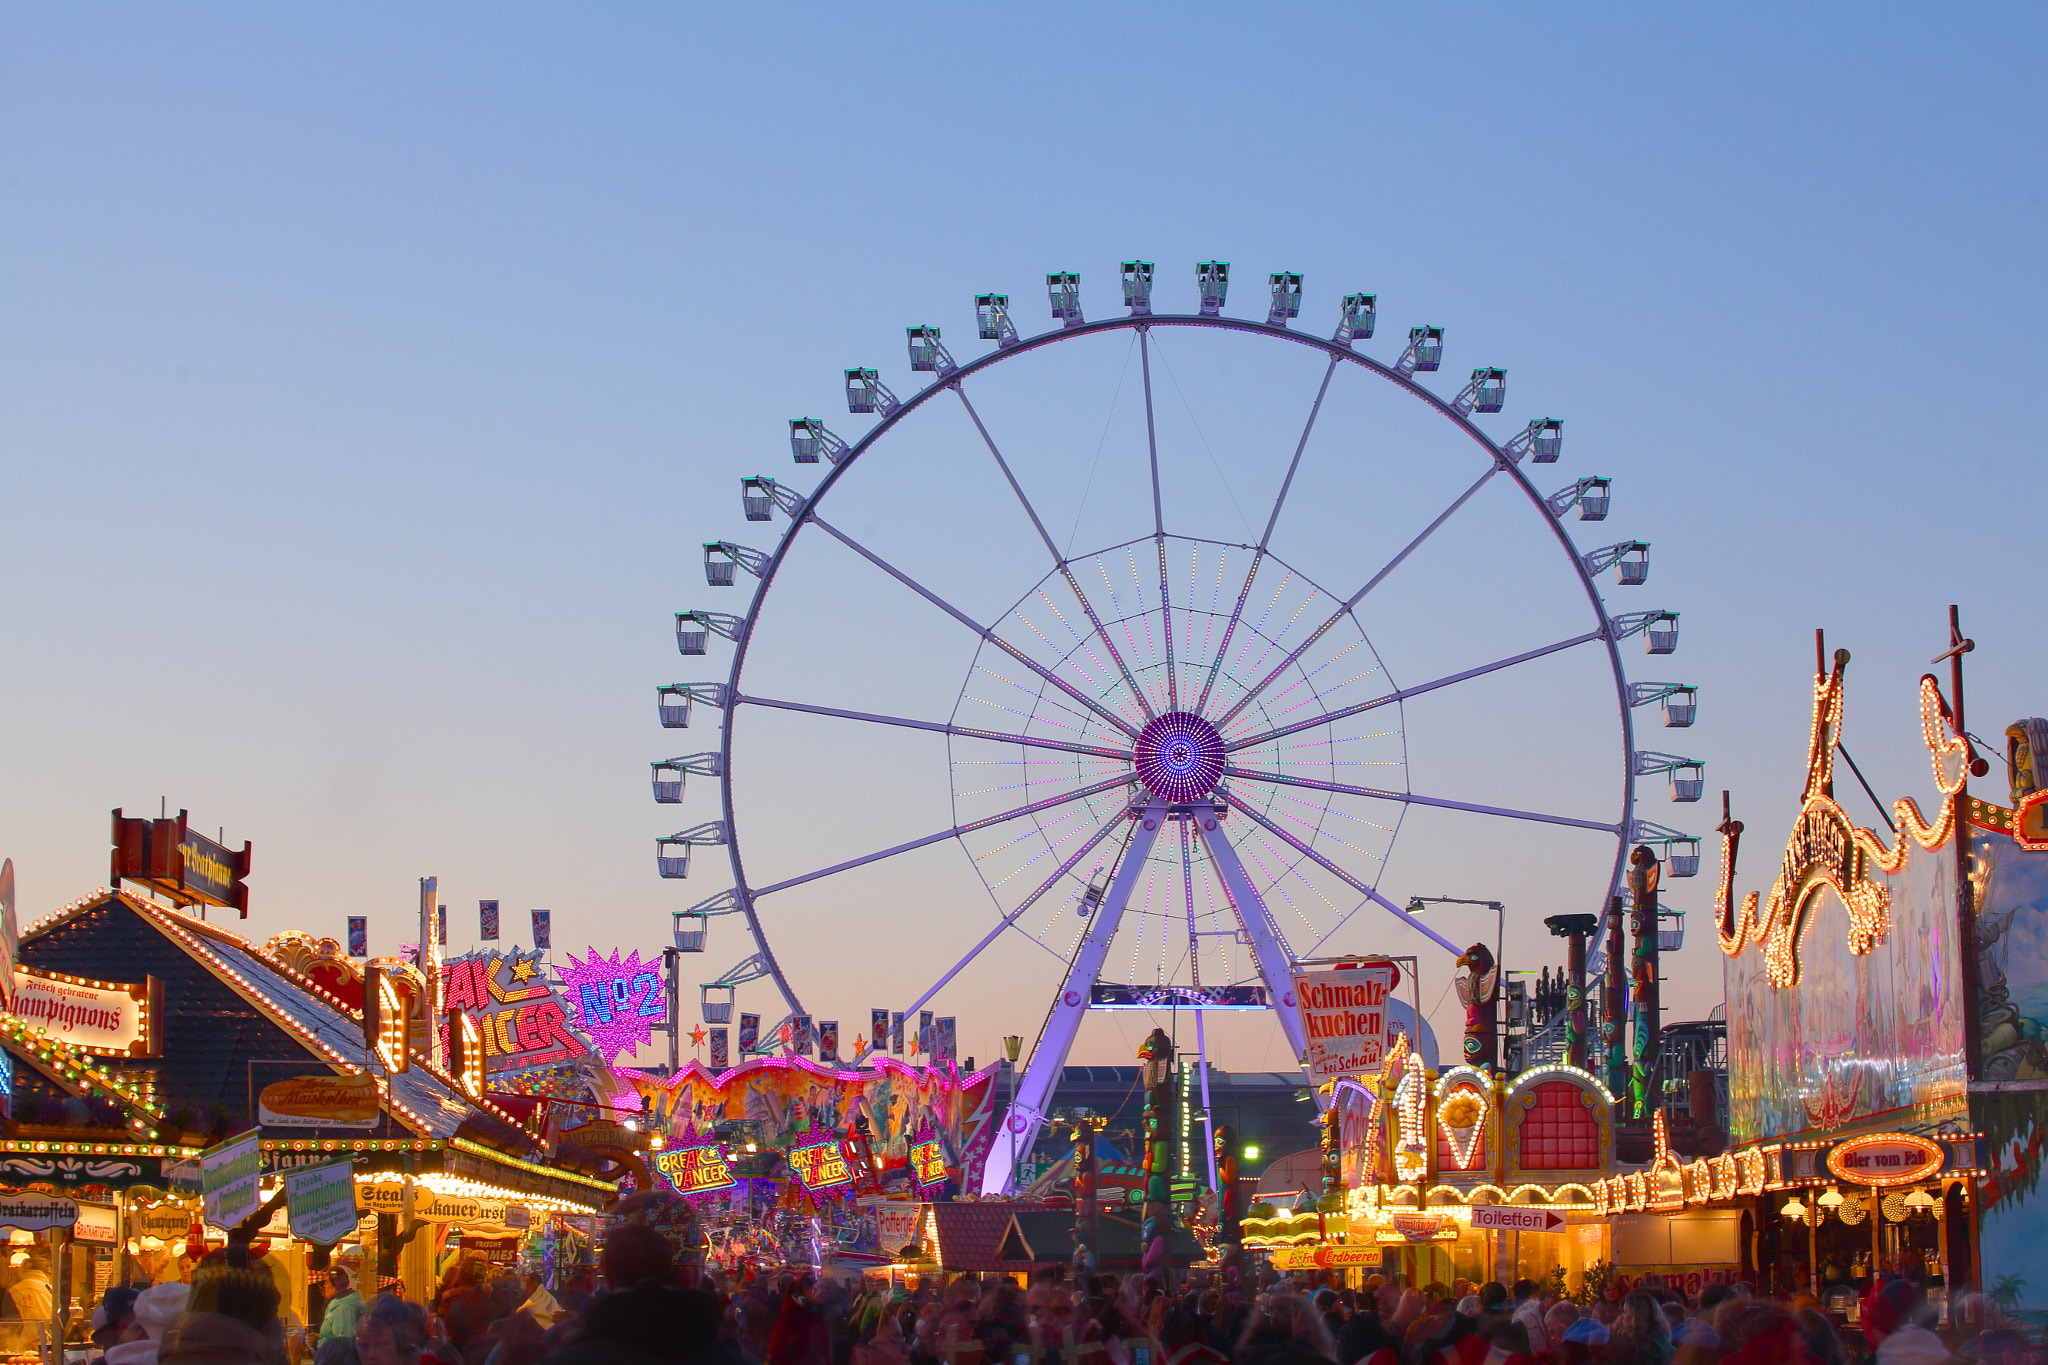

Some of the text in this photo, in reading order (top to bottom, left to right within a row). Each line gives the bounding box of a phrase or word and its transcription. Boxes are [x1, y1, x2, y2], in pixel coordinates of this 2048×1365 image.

[26, 980, 99, 1000] Frisch gebratene
[1300, 981, 1388, 1010] Schmalz-
[10, 988, 122, 1032] hampignons
[1305, 1011, 1380, 1038] kuchen
[1323, 1045, 1382, 1075] bei Schau!
[279, 1089, 361, 1106] Maiskolben
[658, 1148, 721, 1173] BREAK
[791, 1146, 841, 1168] BREAK
[911, 1143, 941, 1164] BREAK
[1843, 1150, 1926, 1168] Bier vom Faß
[672, 1164, 729, 1188] DANCER
[802, 1161, 847, 1183] DANCER
[917, 1159, 945, 1179] DANCER
[294, 1172, 322, 1191] Frische
[140, 1211, 189, 1235] Champignons
[1474, 1209, 1543, 1228] Toiletten
[1325, 1250, 1379, 1264] Erdbeeren
